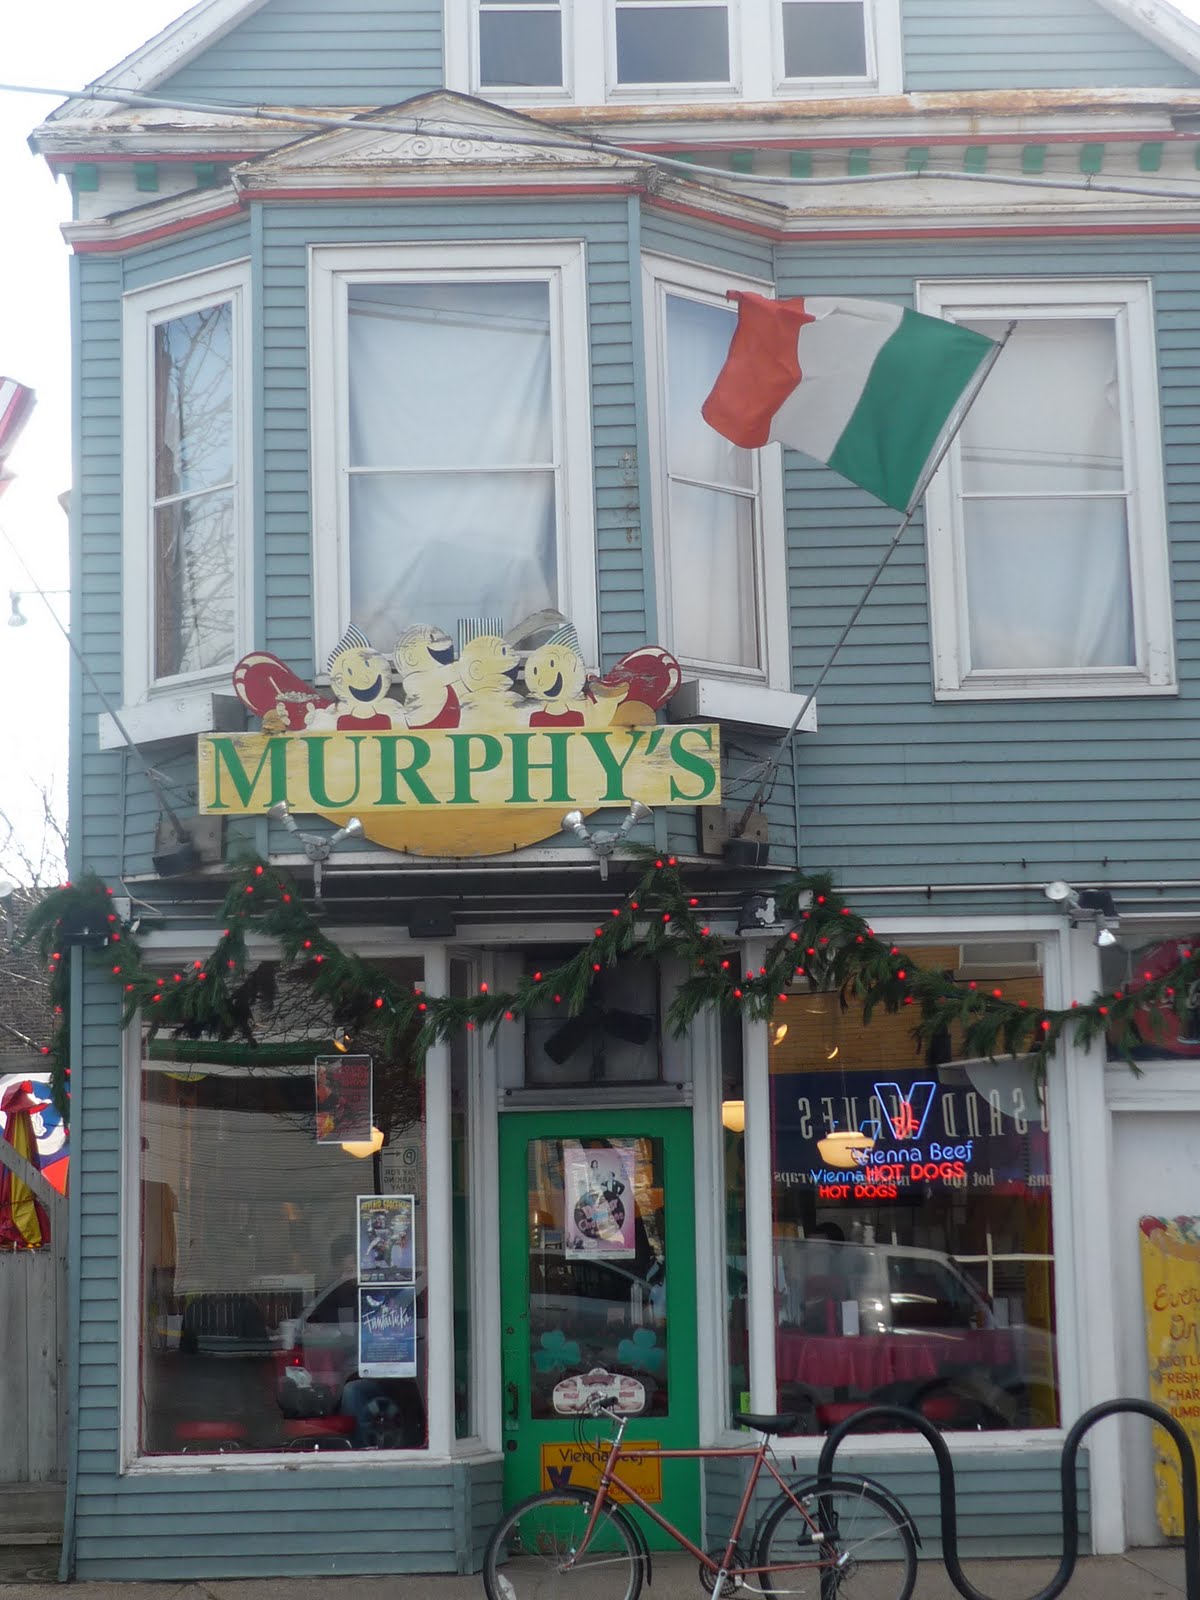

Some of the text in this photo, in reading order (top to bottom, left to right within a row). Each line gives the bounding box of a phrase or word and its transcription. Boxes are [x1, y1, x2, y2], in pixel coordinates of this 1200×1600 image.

[206, 727, 717, 810] MURPHY'S
[851, 1140, 974, 1166] Vienna Beef
[865, 1161, 966, 1182] HOT DOGS
[819, 1185, 898, 1199] HOT DOGS
[1161, 1372, 1200, 1384] FRESH
[559, 1448, 609, 1463] Vienna
